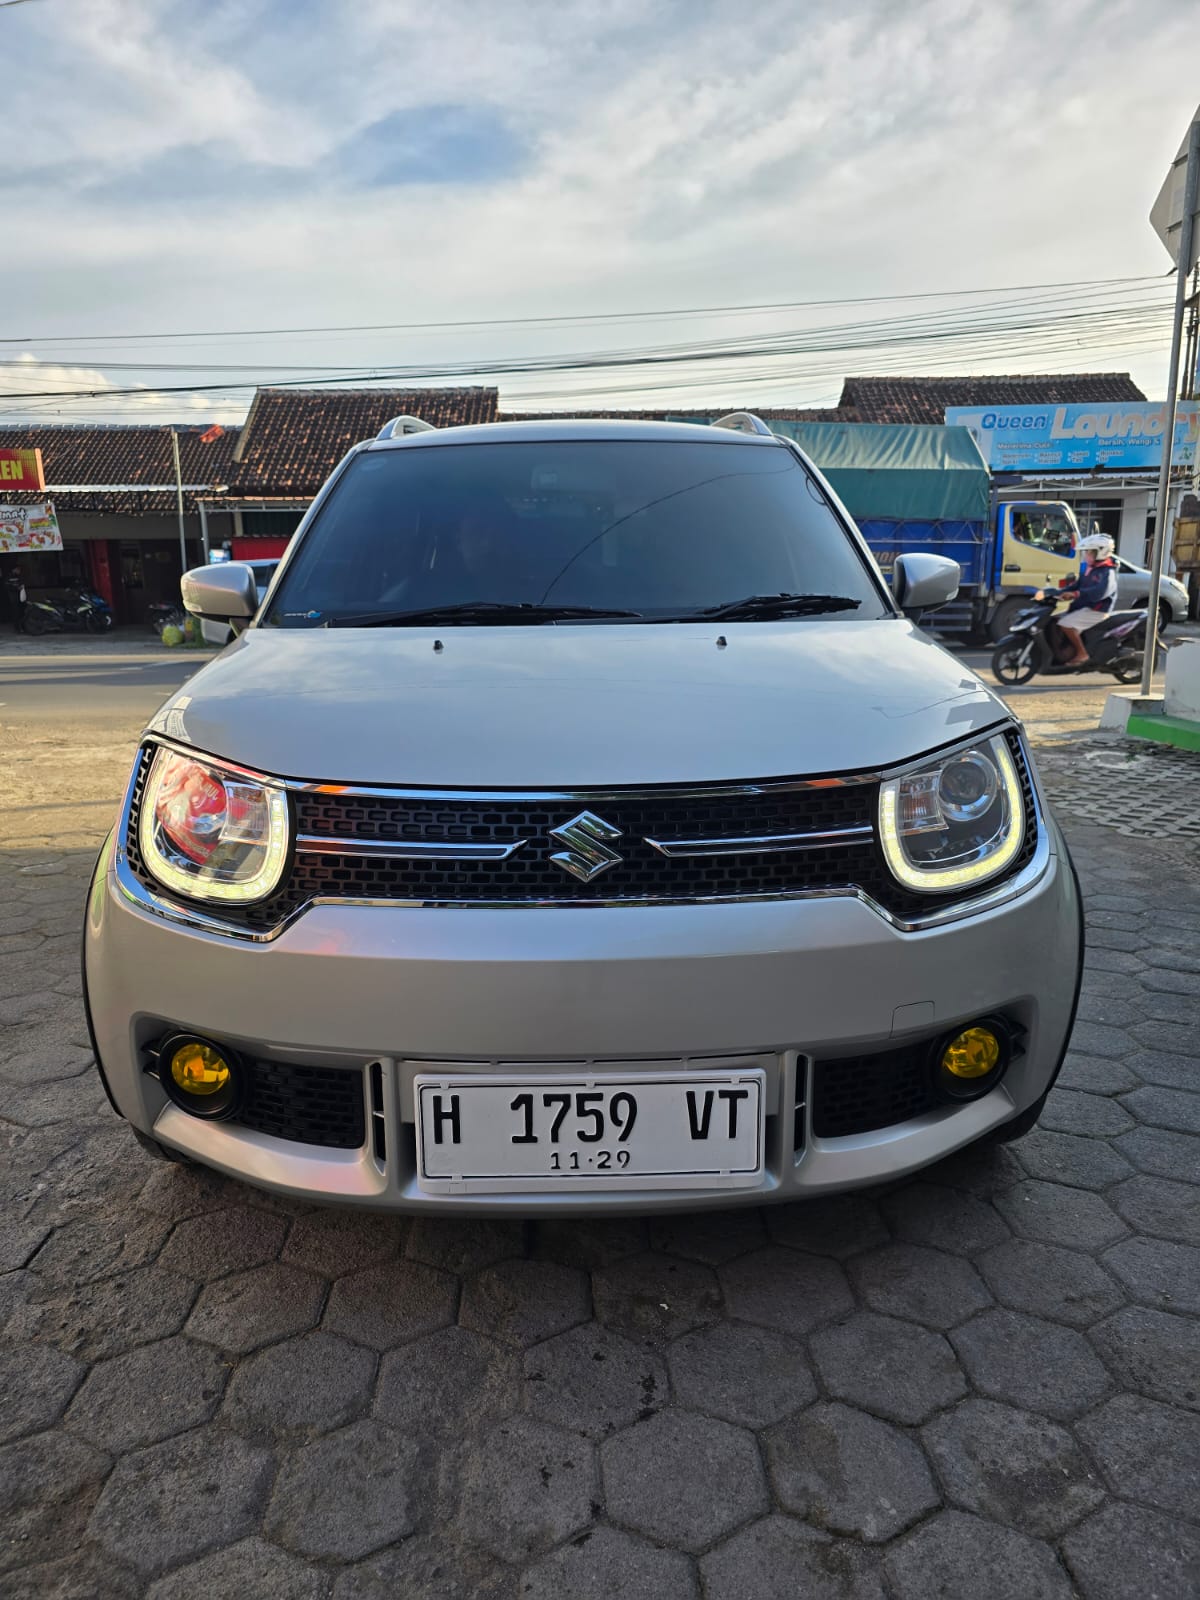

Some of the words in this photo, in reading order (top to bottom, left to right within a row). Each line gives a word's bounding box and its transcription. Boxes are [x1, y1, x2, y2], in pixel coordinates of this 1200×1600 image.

[981, 413, 1048, 430] Queen
[0, 460, 23, 480] EN
[0, 508, 26, 520] mat
[432, 1094, 461, 1145] H
[510, 1091, 638, 1144] 1759
[685, 1089, 749, 1140] VT
